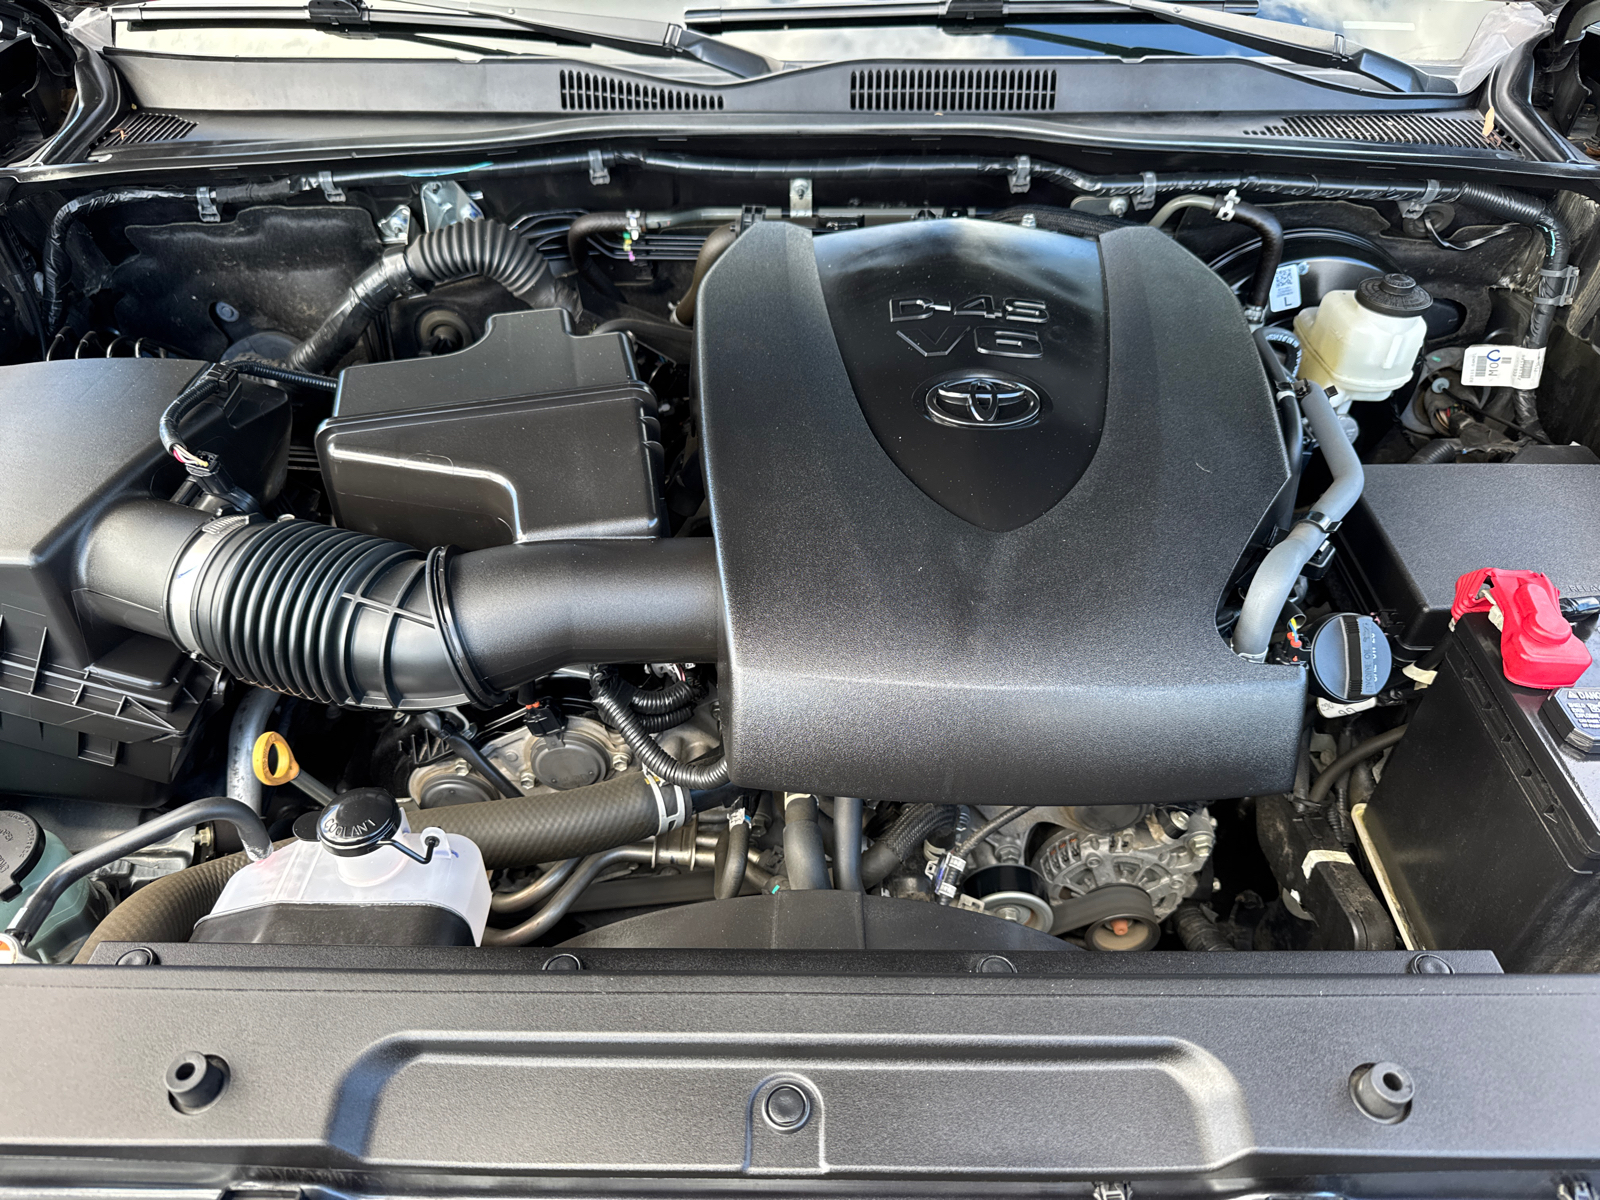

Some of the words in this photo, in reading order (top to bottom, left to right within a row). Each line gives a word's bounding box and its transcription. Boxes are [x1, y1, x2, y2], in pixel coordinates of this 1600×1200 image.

[889, 295, 1050, 323] D-4S
[1284, 296, 1292, 307] L
[896, 325, 1044, 359] V6
[1363, 648, 1372, 660] OIL
[1363, 660, 1374, 693] ENGINE
[324, 818, 376, 838] COOLANT
